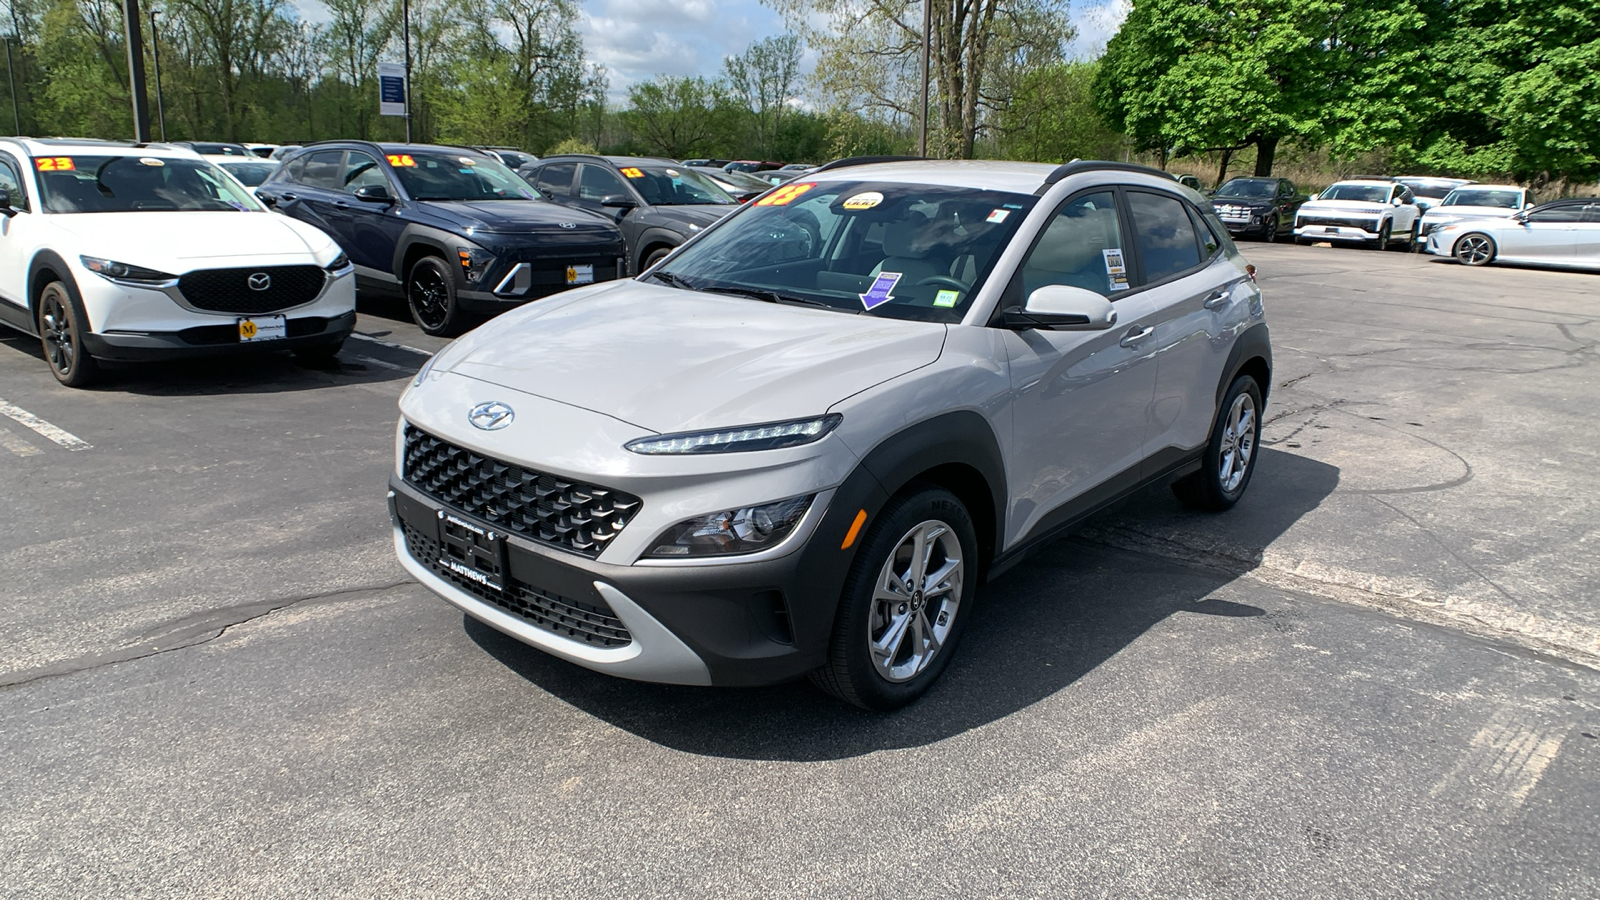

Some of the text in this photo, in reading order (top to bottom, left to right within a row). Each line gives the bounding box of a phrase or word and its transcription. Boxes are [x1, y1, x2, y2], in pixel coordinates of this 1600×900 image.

[38, 157, 72, 170] 23
[387, 155, 414, 167] 26
[243, 325, 254, 335] M
[450, 561, 488, 585] MATTHEWS
